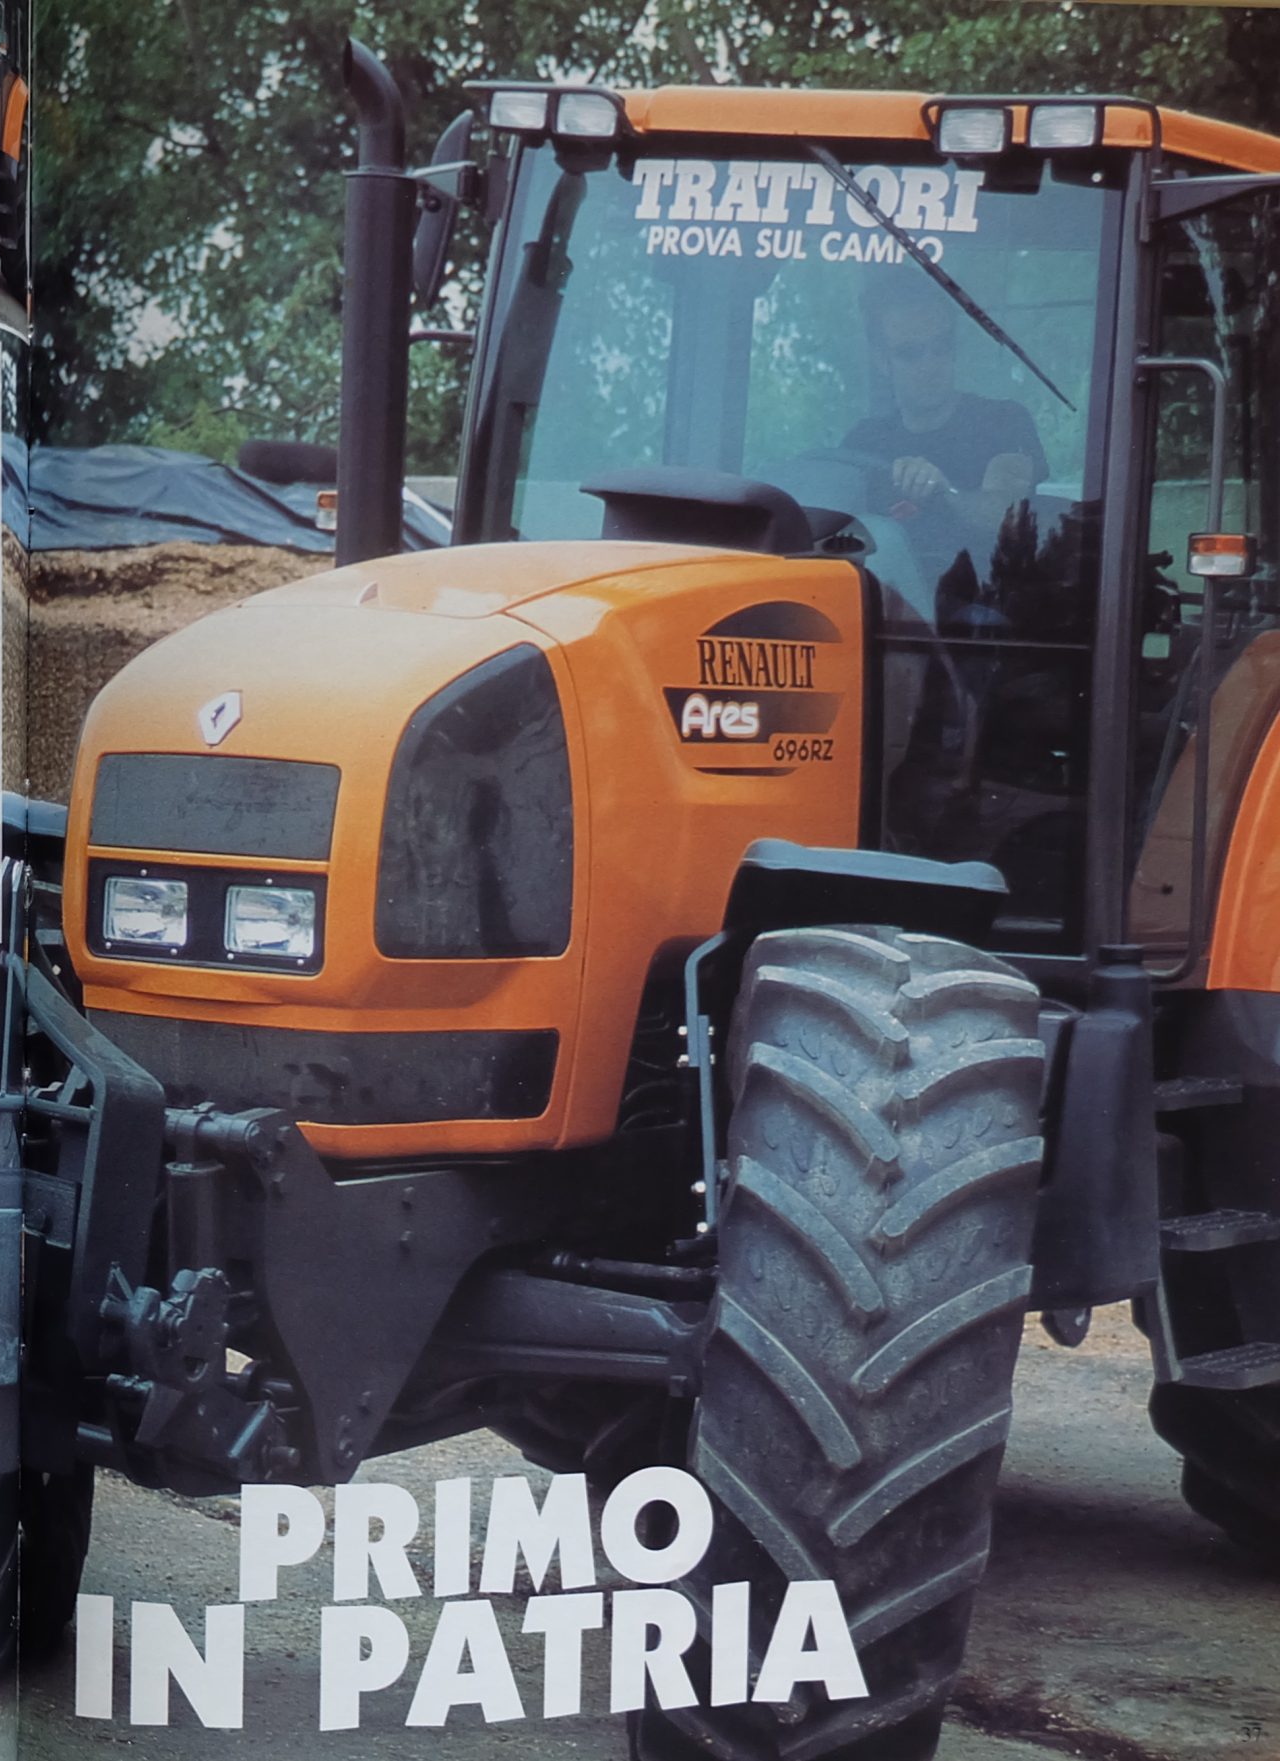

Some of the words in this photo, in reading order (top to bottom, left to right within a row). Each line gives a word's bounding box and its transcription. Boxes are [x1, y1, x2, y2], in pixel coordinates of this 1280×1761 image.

[632, 159, 985, 233] TRATTORI
[646, 225, 743, 257] PROVA
[755, 228, 807, 260] SUL
[697, 638, 817, 689] RENAULT
[680, 692, 760, 739] Ares
[773, 739, 834, 762] 696RZ
[228, 1466, 714, 1602] PRIMO
[75, 1594, 245, 1729] IN
[320, 1579, 869, 1732] PATRIA
